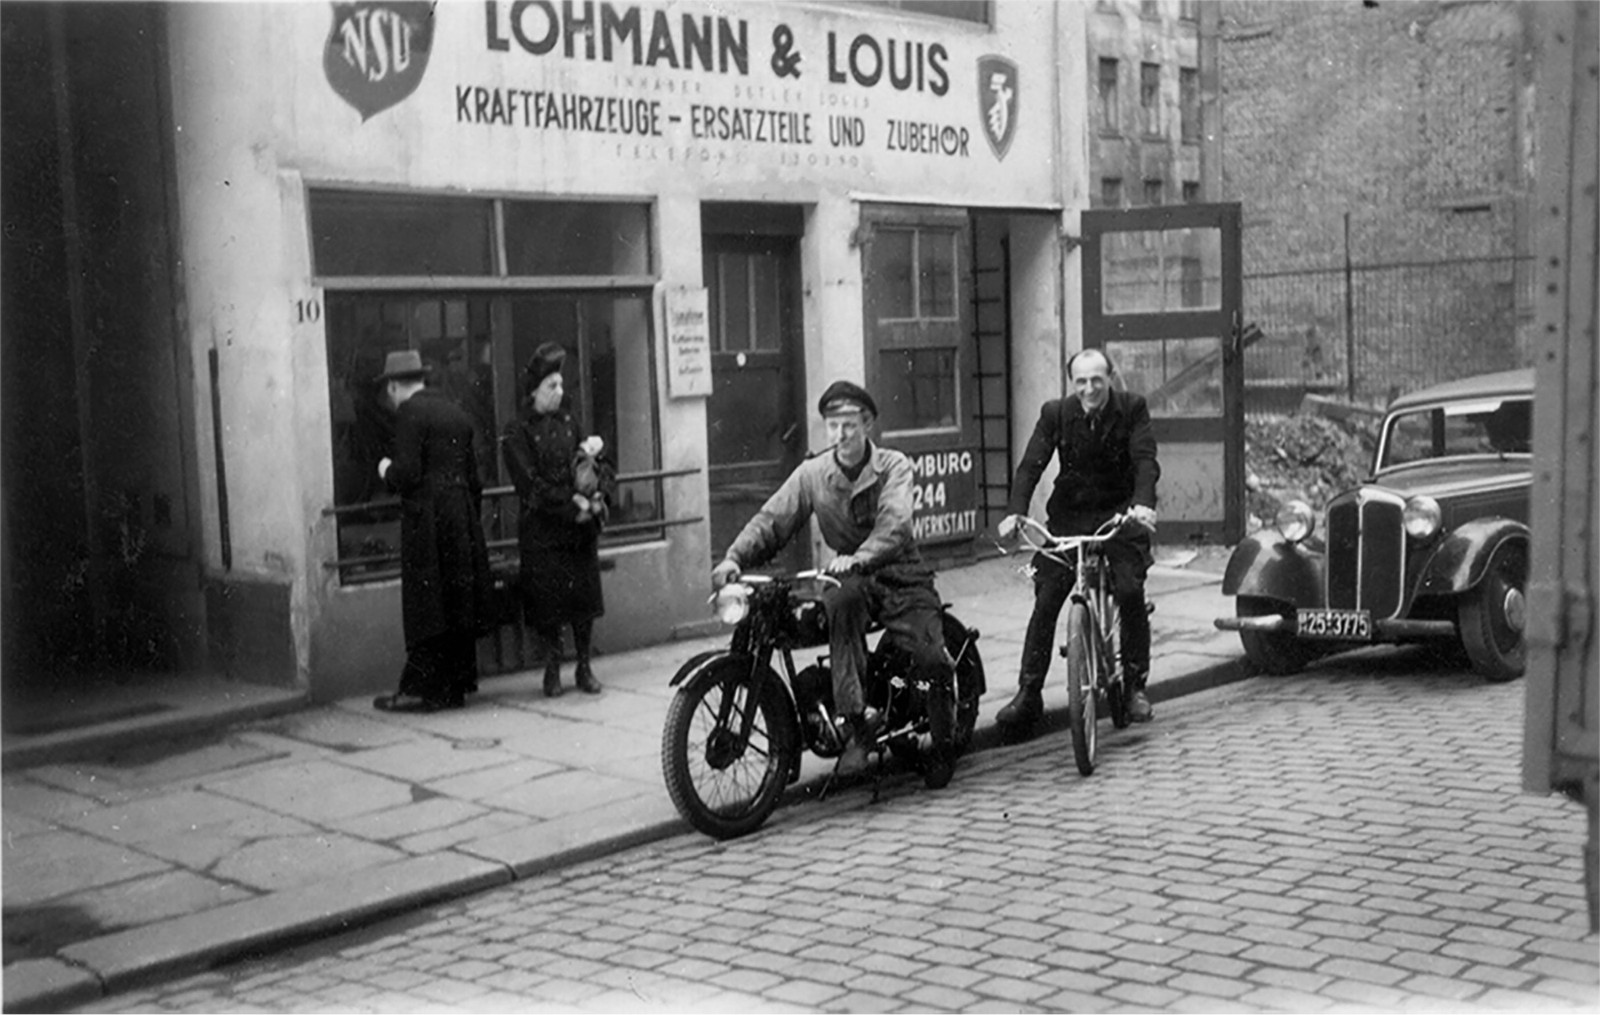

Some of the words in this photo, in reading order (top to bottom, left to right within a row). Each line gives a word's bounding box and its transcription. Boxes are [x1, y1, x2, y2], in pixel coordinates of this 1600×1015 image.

[341, 8, 412, 82] NSU
[485, 0, 749, 76] LOHMANN
[771, 24, 802, 79] &
[827, 31, 949, 97] LOUIS
[456, 85, 662, 137] KRAFTFAHRZEUGE
[691, 104, 813, 145] ERSATZTEILE
[828, 115, 866, 147] UND
[294, 299, 321, 324] 10
[909, 451, 972, 478] MBURG
[913, 482, 946, 510] 244
[912, 509, 977, 540] WERKSTATT
